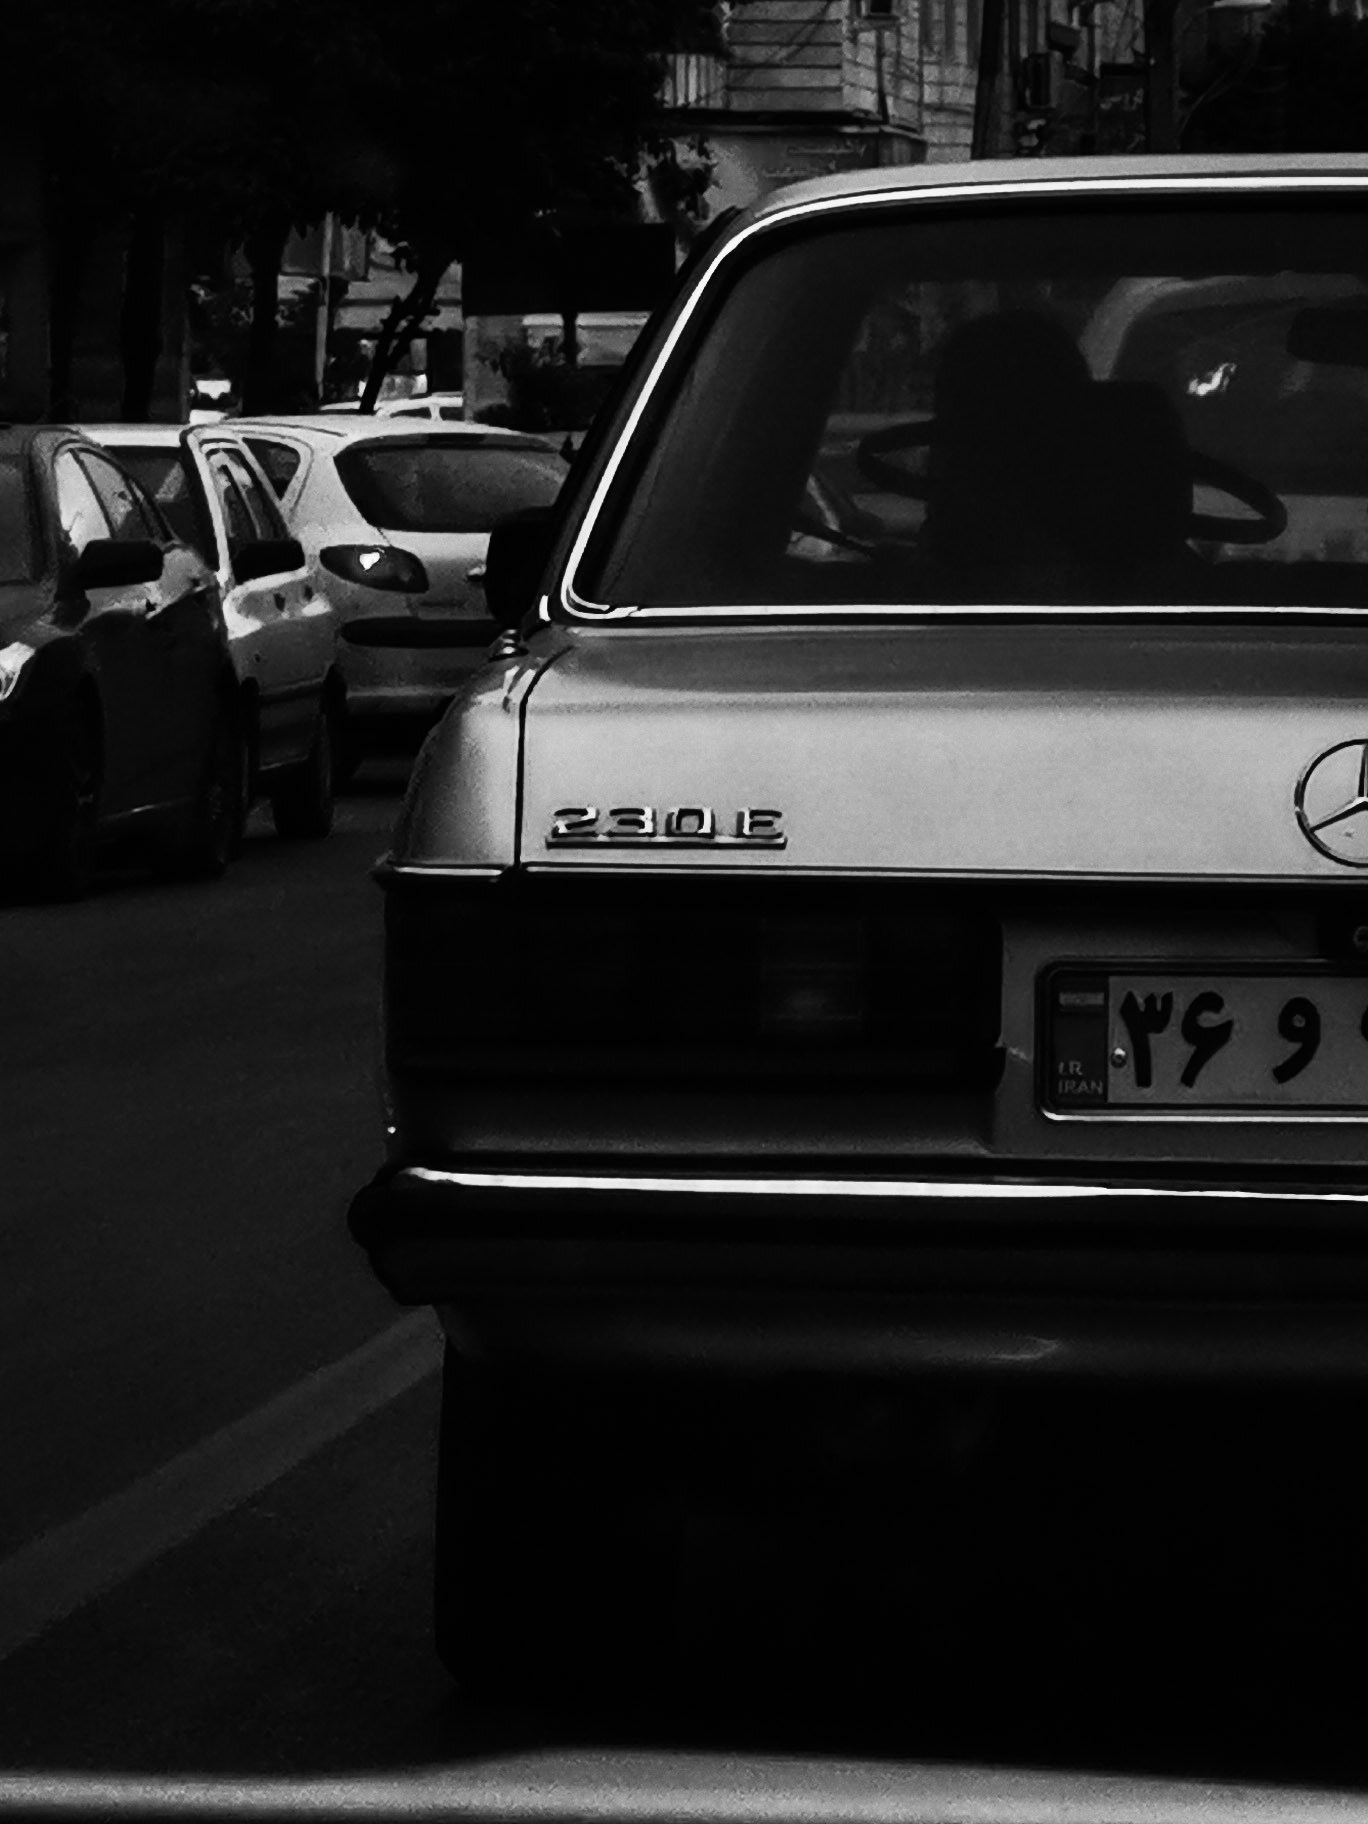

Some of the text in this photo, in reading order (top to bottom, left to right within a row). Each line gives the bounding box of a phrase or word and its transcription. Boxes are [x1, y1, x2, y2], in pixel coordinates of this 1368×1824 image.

[553, 808, 785, 840] 230 E
[1057, 1079, 1104, 1095] IRAN
